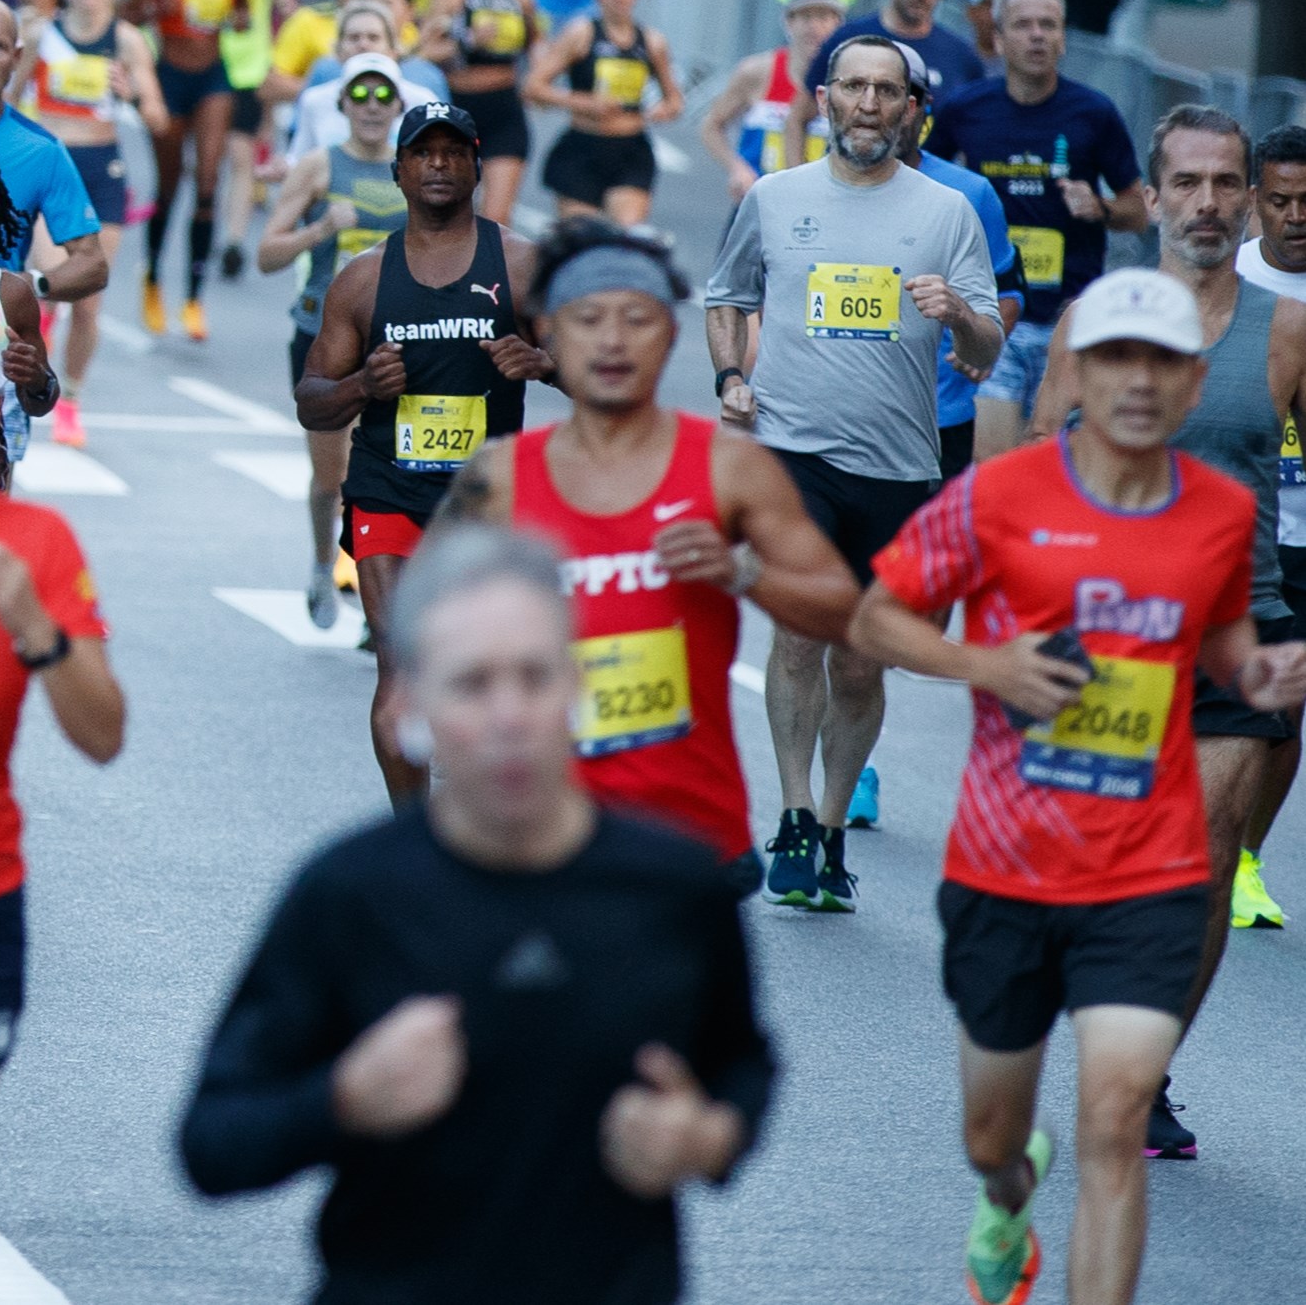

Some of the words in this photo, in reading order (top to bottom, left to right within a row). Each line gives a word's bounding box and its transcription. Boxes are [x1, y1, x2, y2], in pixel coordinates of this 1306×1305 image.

[840, 296, 882, 319] 605
[384, 317, 496, 342] teamWRK
[423, 428, 474, 451] 2427
[596, 678, 676, 721] 8230
[1067, 704, 1153, 744] 2048
